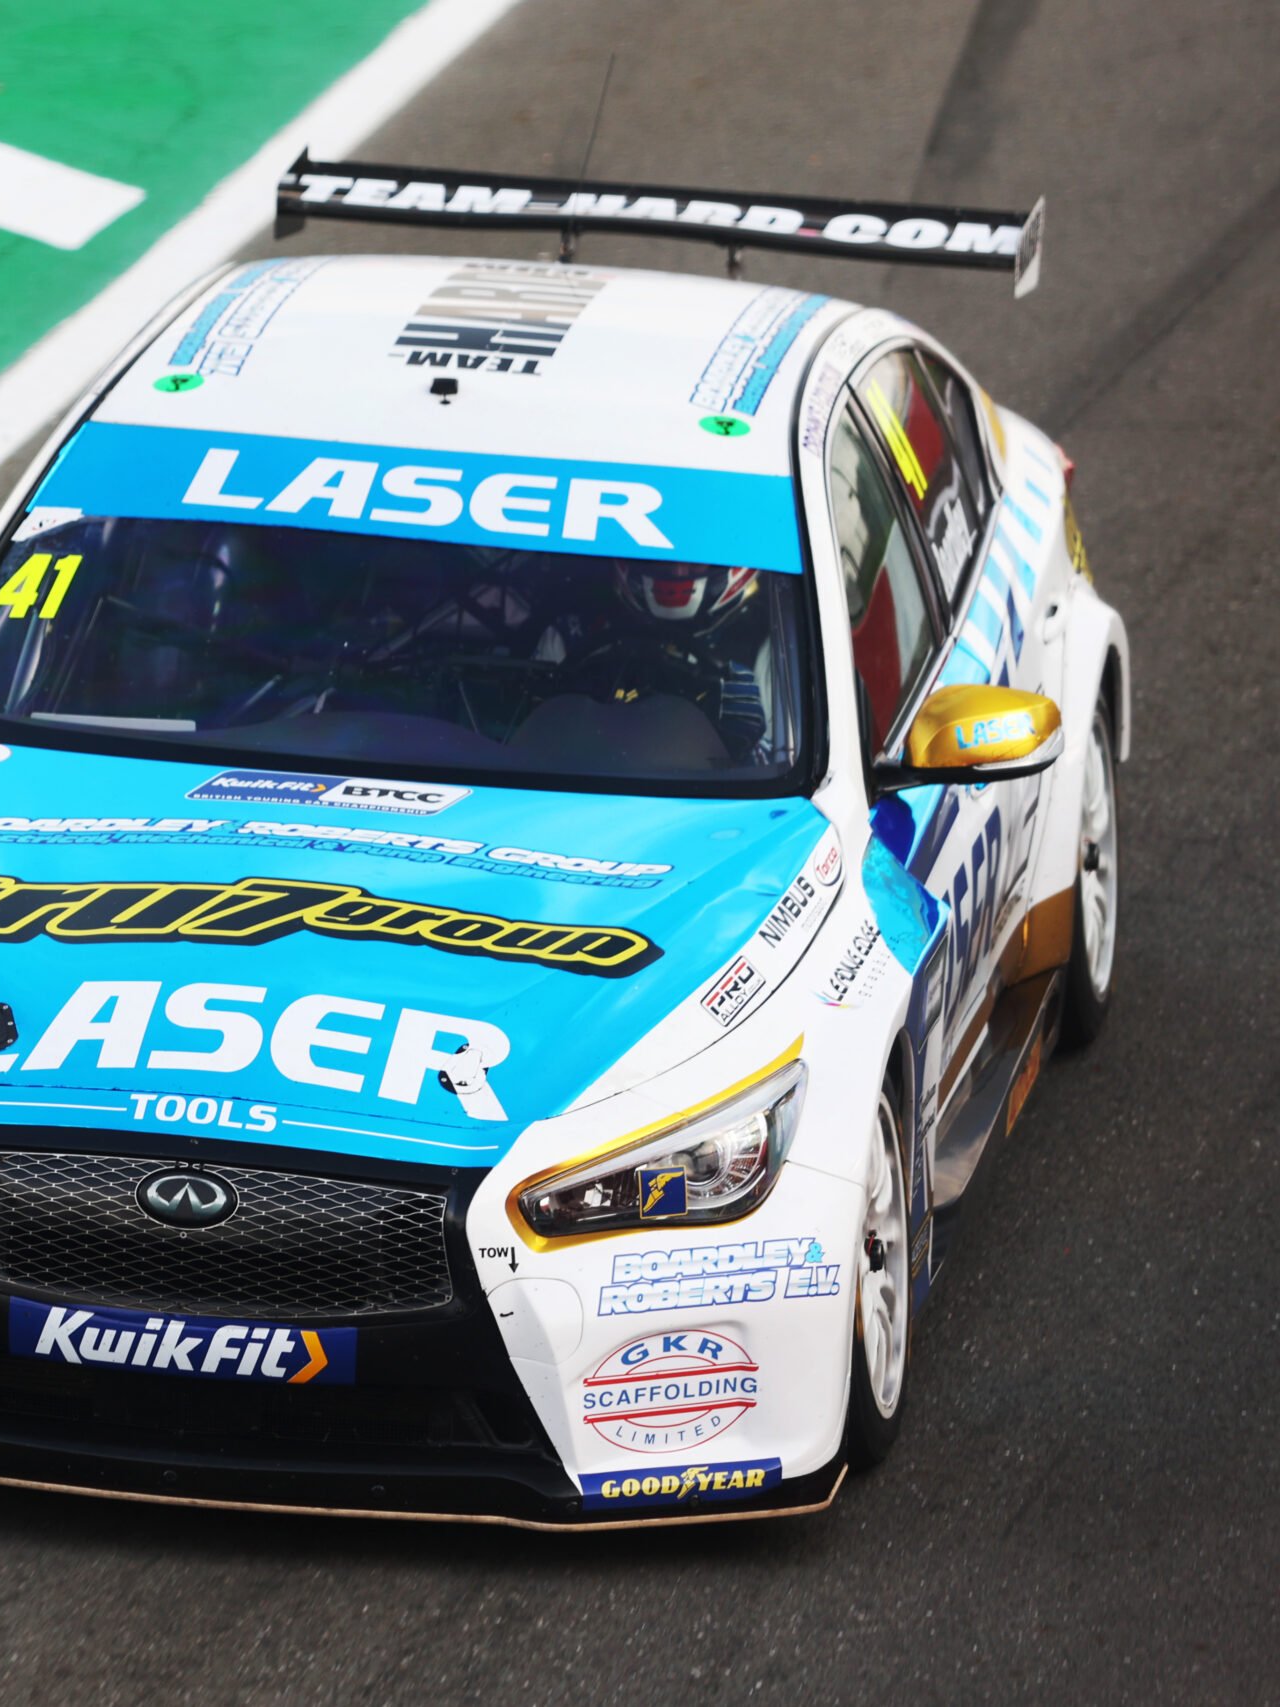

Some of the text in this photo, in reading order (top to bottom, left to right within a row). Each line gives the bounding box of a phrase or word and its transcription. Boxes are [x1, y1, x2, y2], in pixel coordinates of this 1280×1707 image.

[182, 448, 675, 549] LASER
[955, 713, 1036, 749] LASER
[193, 793, 428, 815] BRITISH TOURING CAR CHAMPIONSHIP
[342, 786, 444, 804] BTCC
[236, 820, 487, 854] ROBERTS
[486, 847, 675, 876] GROUP
[346, 844, 446, 864] Pump
[444, 855, 664, 890] Engineering
[759, 876, 816, 949] NIMBUS
[720, 988, 748, 1022] ALLOY
[126, 1093, 277, 1132] TOOLS
[478, 1247, 509, 1259] TOW
[597, 1265, 841, 1317] ROBERTS E.V.
[620, 1335, 723, 1366] GKR
[582, 1377, 758, 1409] SCAFFOLDING
[615, 1414, 721, 1445] LIMITED
[601, 1467, 766, 1499] GOODYEAR
